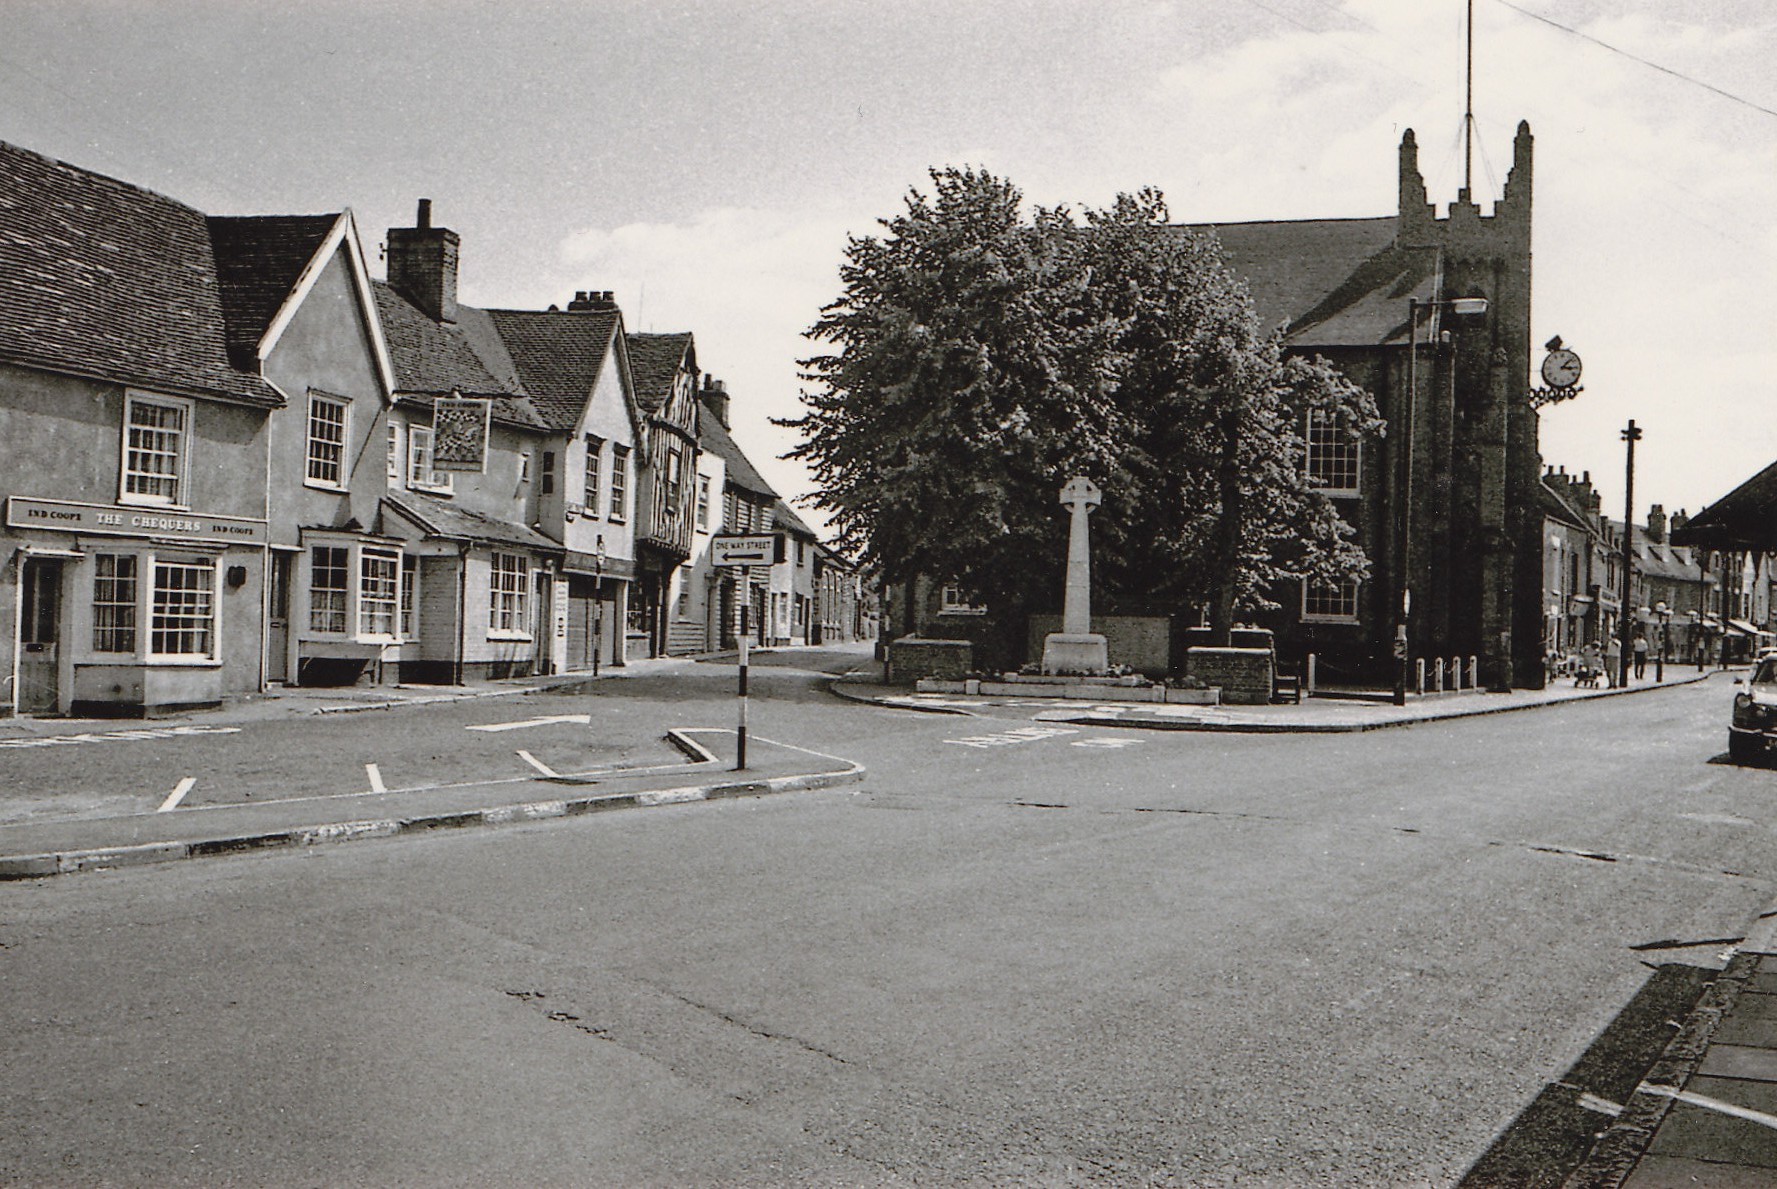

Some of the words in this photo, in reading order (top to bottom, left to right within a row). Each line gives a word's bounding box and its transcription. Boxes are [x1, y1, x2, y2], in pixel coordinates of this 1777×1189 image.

[28, 509, 48, 518] IND
[96, 513, 123, 525] THE
[131, 516, 201, 531] CHEQUERS
[716, 542, 728, 550] ONE
[747, 541, 771, 550] STREET
